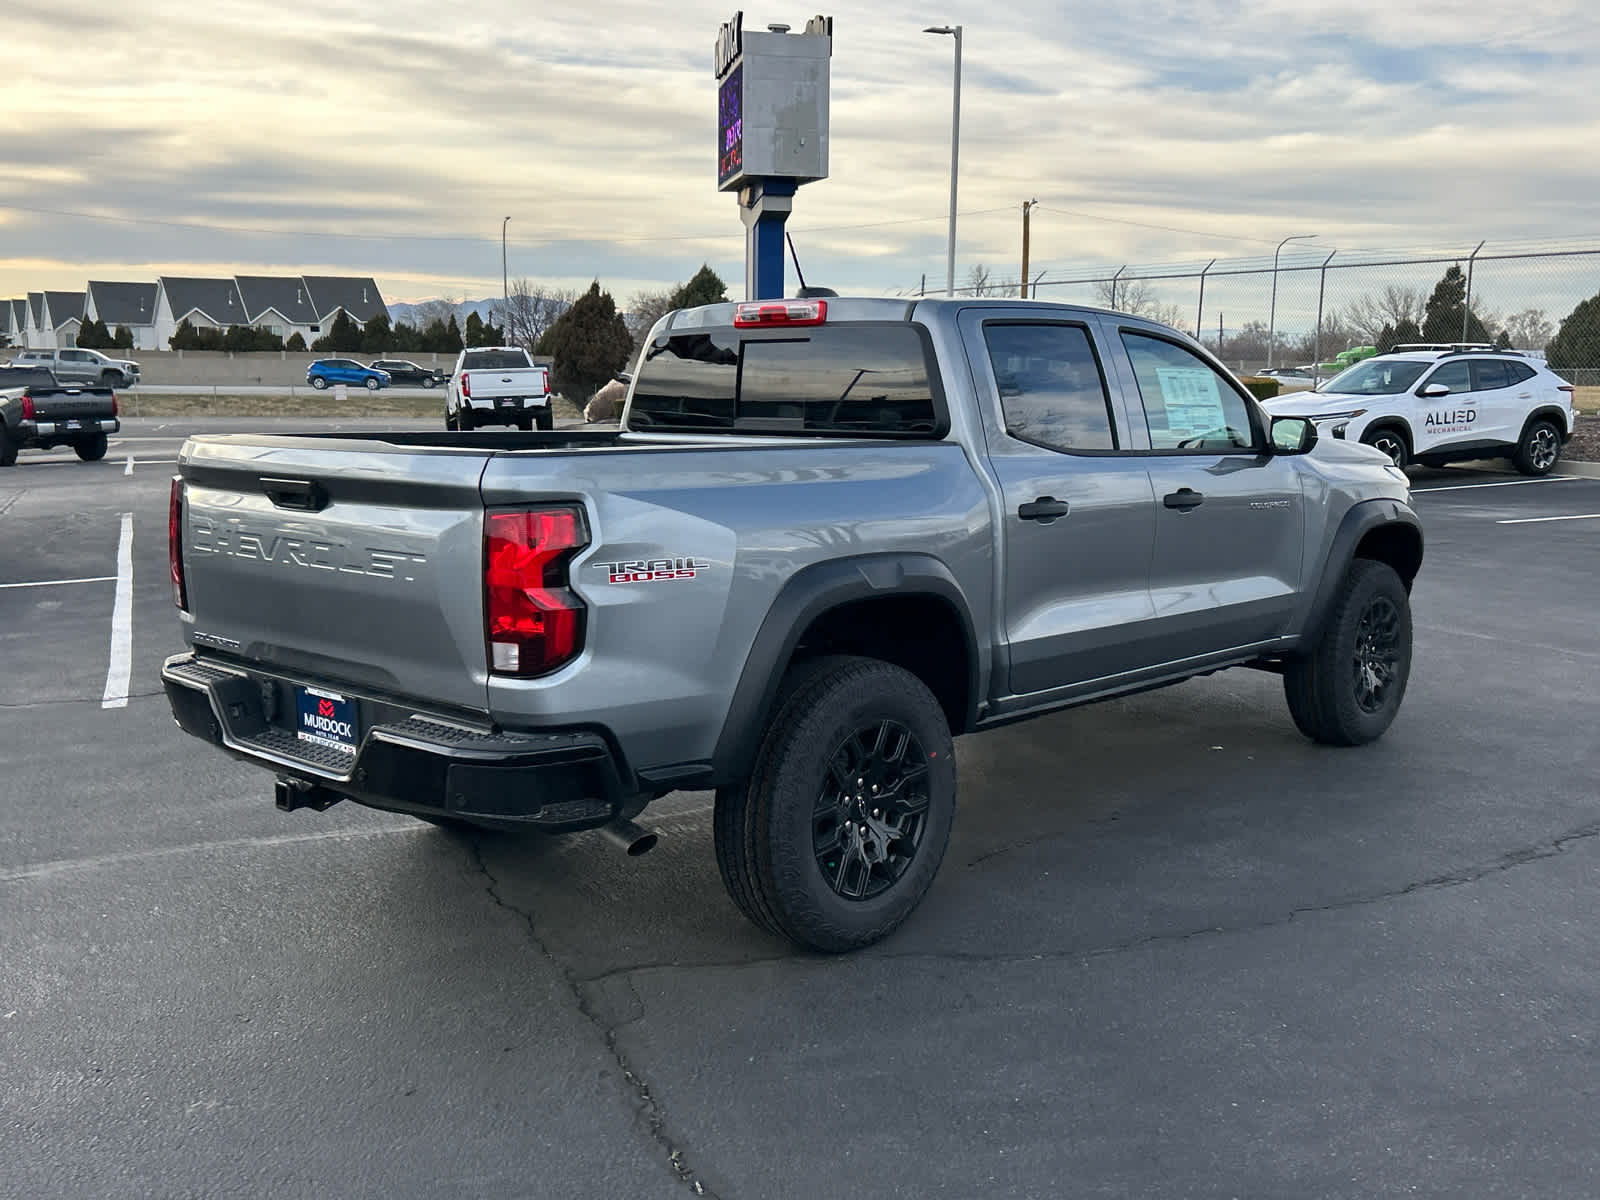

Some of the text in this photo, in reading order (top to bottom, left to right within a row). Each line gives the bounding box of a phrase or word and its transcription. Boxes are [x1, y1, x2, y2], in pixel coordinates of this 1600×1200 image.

[1425, 410, 1476, 426] ALLIED
[592, 557, 710, 574] TRAIL
[609, 569, 696, 584] BOSS
[304, 712, 351, 737] MURDOCK
